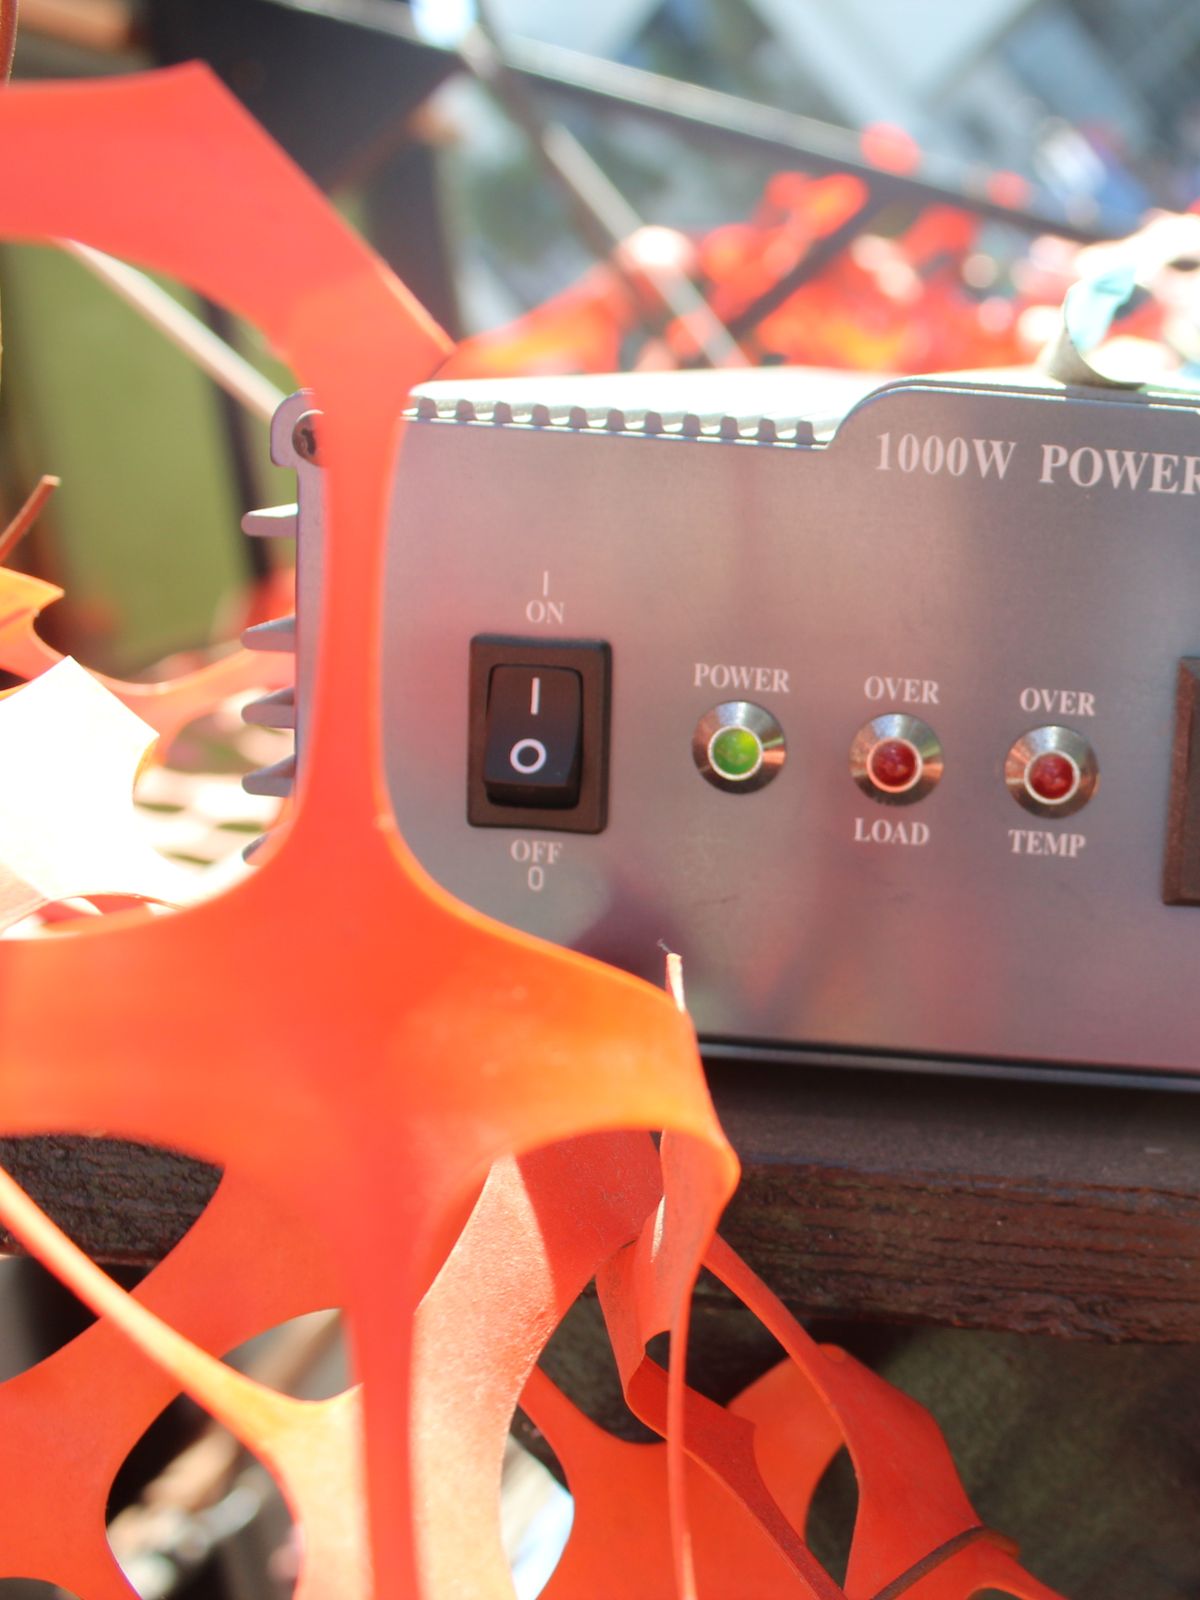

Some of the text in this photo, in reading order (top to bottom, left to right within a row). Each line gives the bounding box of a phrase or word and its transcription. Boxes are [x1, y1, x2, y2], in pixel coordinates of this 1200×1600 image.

[875, 431, 1016, 481] 1000W
[525, 600, 565, 624] ON
[692, 662, 790, 693] POWER
[863, 675, 940, 704] OVER
[1019, 687, 1096, 717] OVER
[853, 817, 931, 846] LOAD
[1008, 829, 1086, 858] TEMP
[510, 839, 562, 864] OFF
